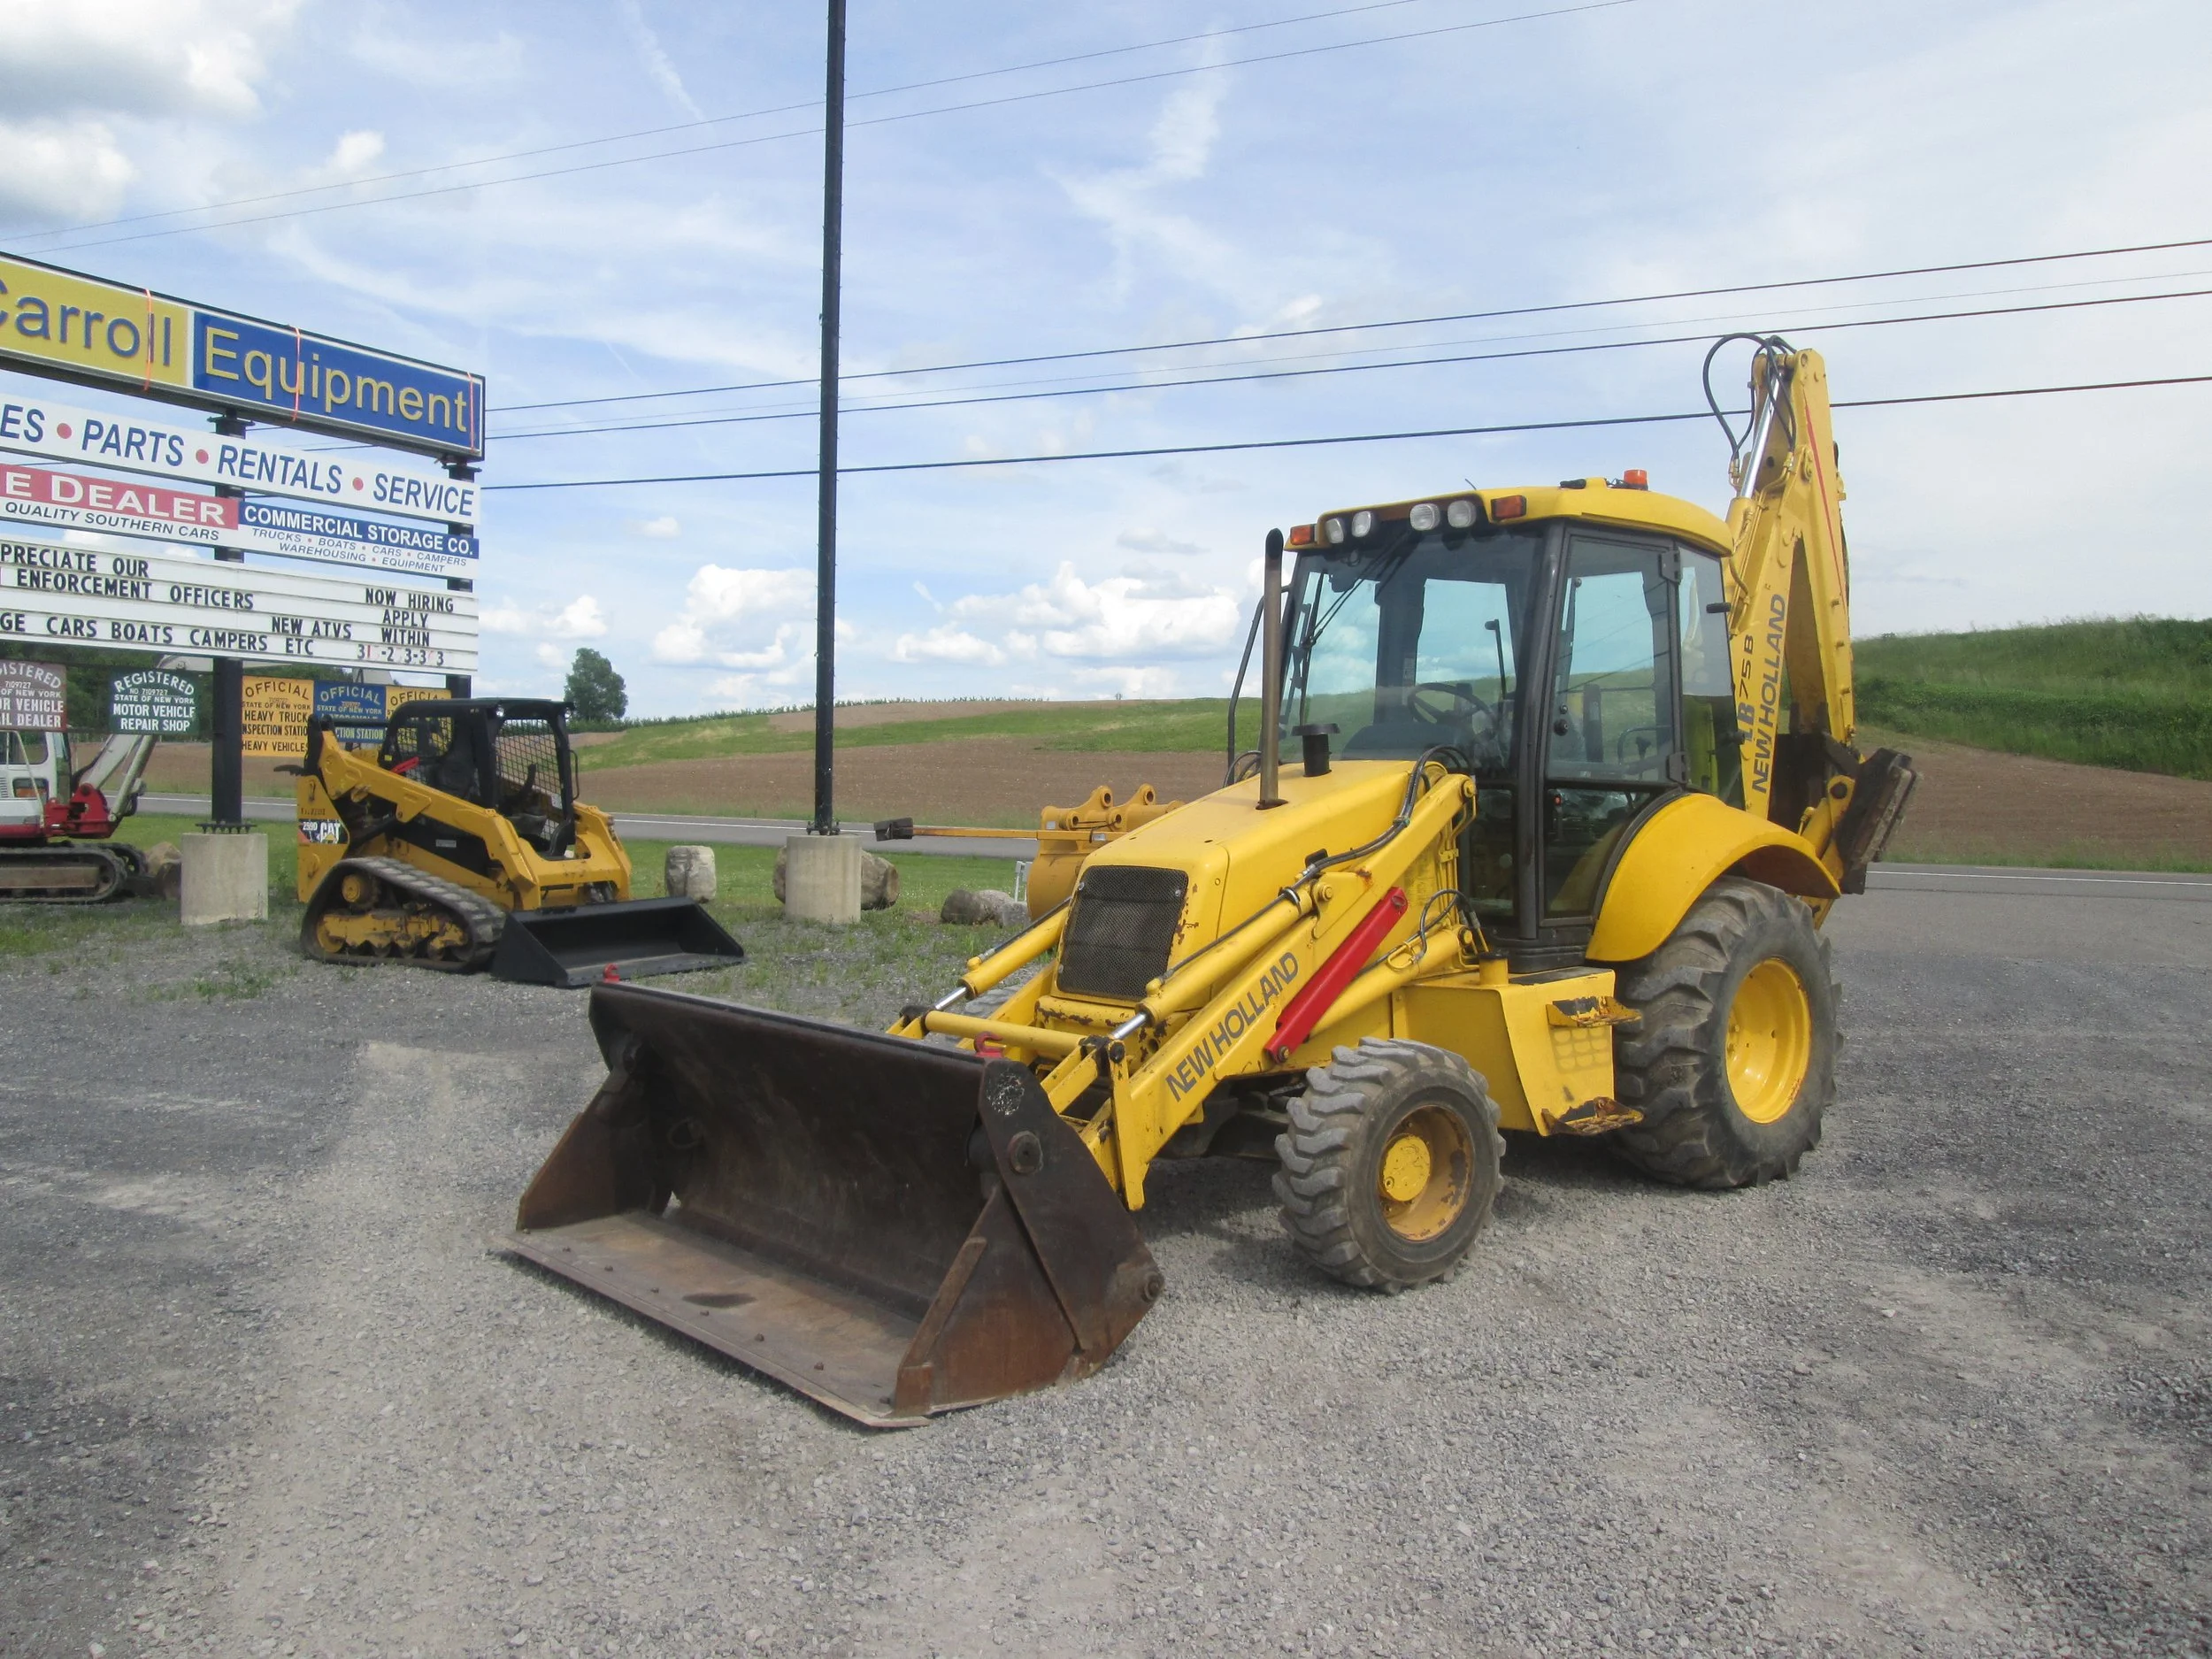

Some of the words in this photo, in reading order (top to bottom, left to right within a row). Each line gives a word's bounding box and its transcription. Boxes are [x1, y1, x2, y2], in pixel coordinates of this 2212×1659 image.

[0, 279, 172, 366] arroll
[205, 326, 467, 433] Equipment
[81, 419, 185, 466] PARTS
[217, 444, 342, 494] RENTALS
[373, 472, 474, 517] SERVICE
[51, 474, 226, 526] DEALER
[4, 501, 81, 522] QUALITY
[84, 511, 174, 534] SOUTHERN
[178, 526, 219, 541] CARS
[244, 504, 363, 539] COMMERCIAL
[367, 524, 444, 550] STORAGE
[448, 537, 473, 556] CO.
[251, 527, 302, 542] TRUCKS
[319, 537, 356, 549] BOATS
[372, 545, 402, 557] CARS
[417, 552, 467, 566] CAMPERS
[279, 542, 366, 563] WAREHOUSING
[382, 557, 445, 572] EQUIPMENT
[112, 557, 150, 579] OUR
[17, 567, 152, 600] ENFORCEMENT
[169, 584, 255, 610] OFFICERS
[365, 588, 396, 606] NOW
[408, 593, 454, 612] HIRING
[271, 616, 304, 635] NEW
[311, 619, 352, 638] ATVS
[382, 609, 428, 628] APPLY
[46, 616, 97, 638] CARS
[111, 621, 173, 644] BOATS
[189, 628, 268, 651] CAMPERS
[286, 637, 314, 655] ETC
[381, 627, 430, 647] WITHIN
[1758, 594, 1786, 728] HOLLAND
[0, 662, 61, 688] ISTERED
[113, 671, 195, 695] REGISTERED
[245, 681, 309, 700] OFFICIAL
[320, 686, 380, 705] OFFICIAL
[16, 698, 65, 713] VEHICLE
[113, 703, 150, 717] MOTOR
[152, 704, 196, 718] VEHICLE
[244, 710, 274, 722] HEAVY
[279, 710, 309, 723] TRUCK
[0, 712, 12, 726] IL
[17, 713, 61, 728] DEALER
[120, 718, 159, 731] REPAIR
[162, 719, 190, 732] SHOP
[284, 725, 308, 737] STATIO
[335, 726, 355, 739] CTION
[356, 727, 384, 741] STATION
[242, 741, 268, 751] HEAVY
[1752, 728, 1773, 794] NEW
[319, 822, 341, 844] CAT
[1165, 1038, 1215, 1102] NEW
[1209, 952, 1299, 1056] HOLLAND
